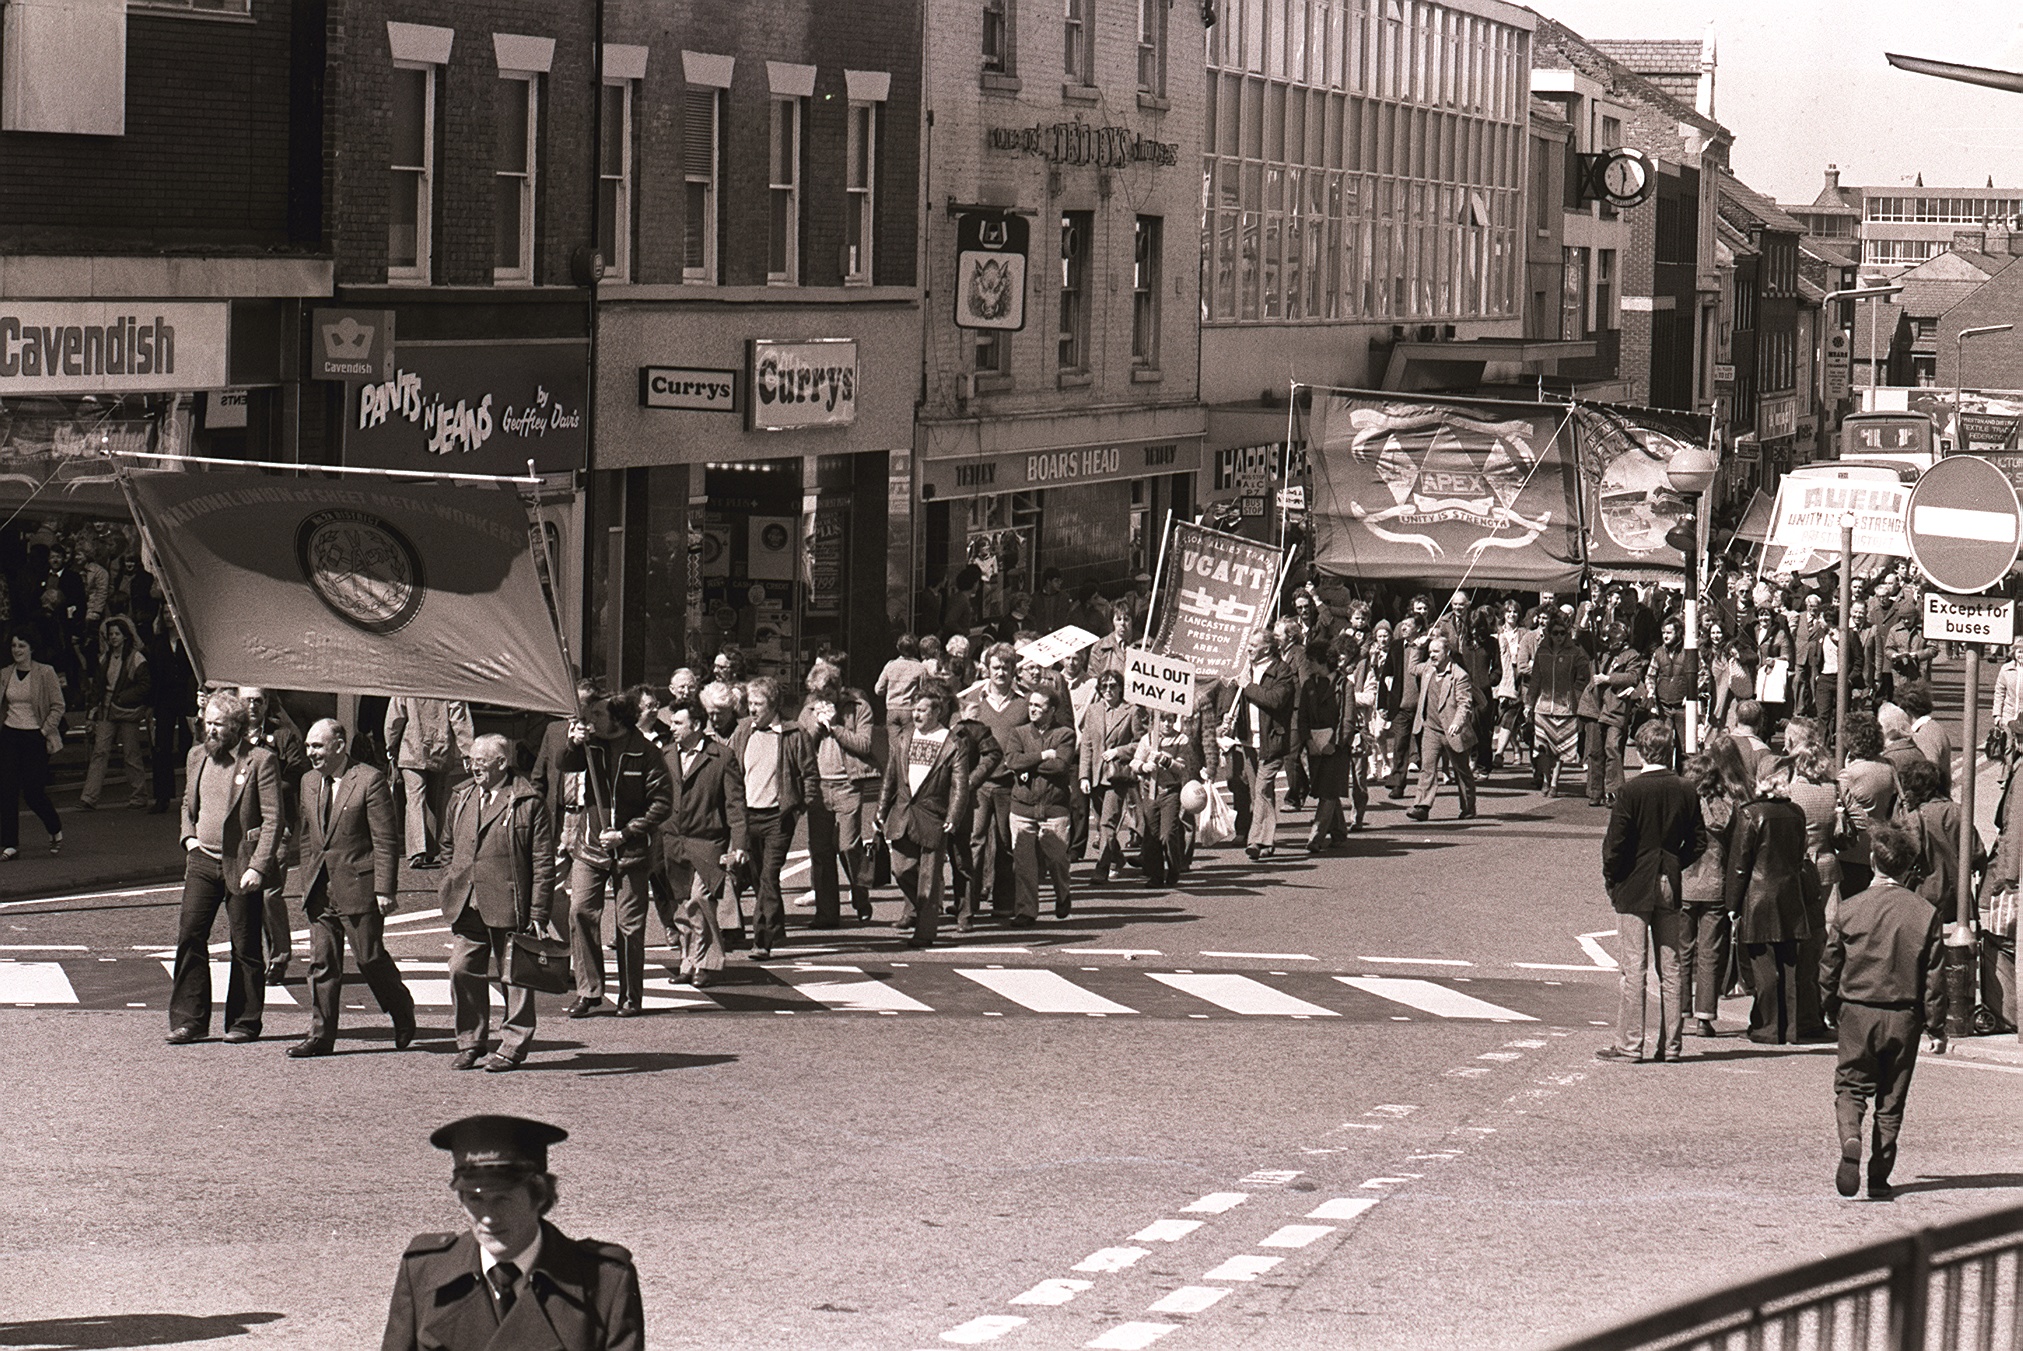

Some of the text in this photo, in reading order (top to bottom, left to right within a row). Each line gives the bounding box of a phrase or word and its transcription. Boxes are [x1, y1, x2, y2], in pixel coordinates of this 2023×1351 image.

[0, 316, 175, 378] Cavendish
[324, 361, 373, 376] Cavendish
[651, 376, 731, 401] Currys
[758, 359, 854, 413] Currys
[536, 385, 549, 409] by
[360, 369, 422, 430] PANTS
[428, 393, 493, 456] JEANS
[550, 402, 580, 430] Davis
[1026, 448, 1120, 482] BOARS HEAD
[1243, 481, 1249, 489] A
[1257, 480, 1264, 489] C
[1423, 473, 1484, 492] APEX
[160, 490, 240, 529] NATIONAL
[236, 487, 295, 505] UNION
[1243, 506, 1263, 514] STOP
[1245, 499, 1261, 507] BUS
[334, 510, 380, 527] DISTRICT
[1401, 510, 1508, 528] UNITY IS STRENGTH
[1860, 516, 1906, 534] STRENG
[1181, 550, 1266, 590] UCATT
[1929, 599, 2009, 618] Except for
[1184, 615, 1236, 632] LANCASTER
[1946, 619, 1990, 635] buses
[1187, 629, 1231, 644] PRESTON
[1192, 643, 1219, 654] AREA
[1207, 657, 1233, 667] WEST
[1131, 660, 1191, 686] ALL OUT
[1195, 667, 1219, 676] GION
[1132, 681, 1186, 706] MAY 14
